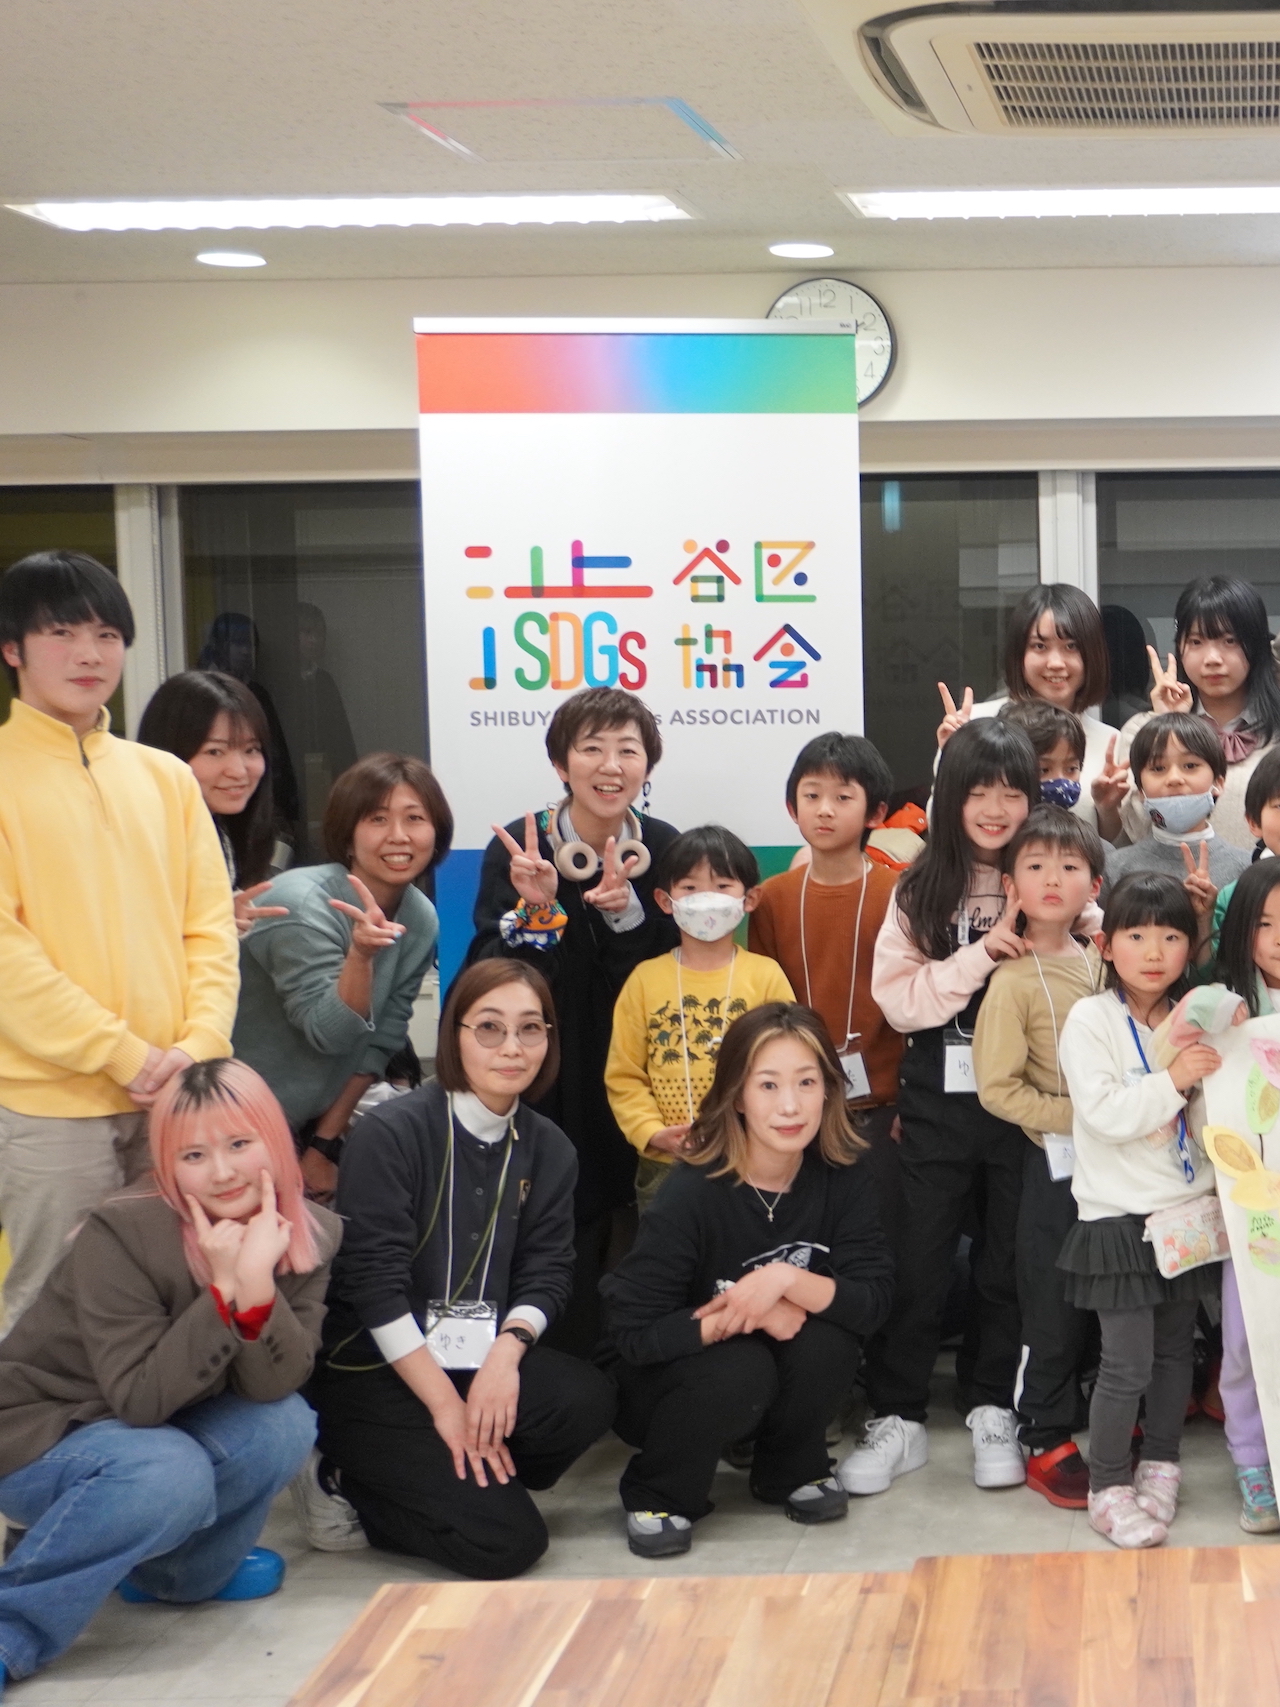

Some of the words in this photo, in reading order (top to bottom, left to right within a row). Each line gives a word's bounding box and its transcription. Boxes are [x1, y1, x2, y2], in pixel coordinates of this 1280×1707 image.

[818, 288, 837, 309] 12
[862, 311, 877, 332] 2
[872, 335, 886, 356] 3
[863, 360, 876, 379] 4
[514, 611, 648, 691] SDGs
[674, 623, 822, 689] 協会
[669, 709, 821, 727] ASSOCIATION
